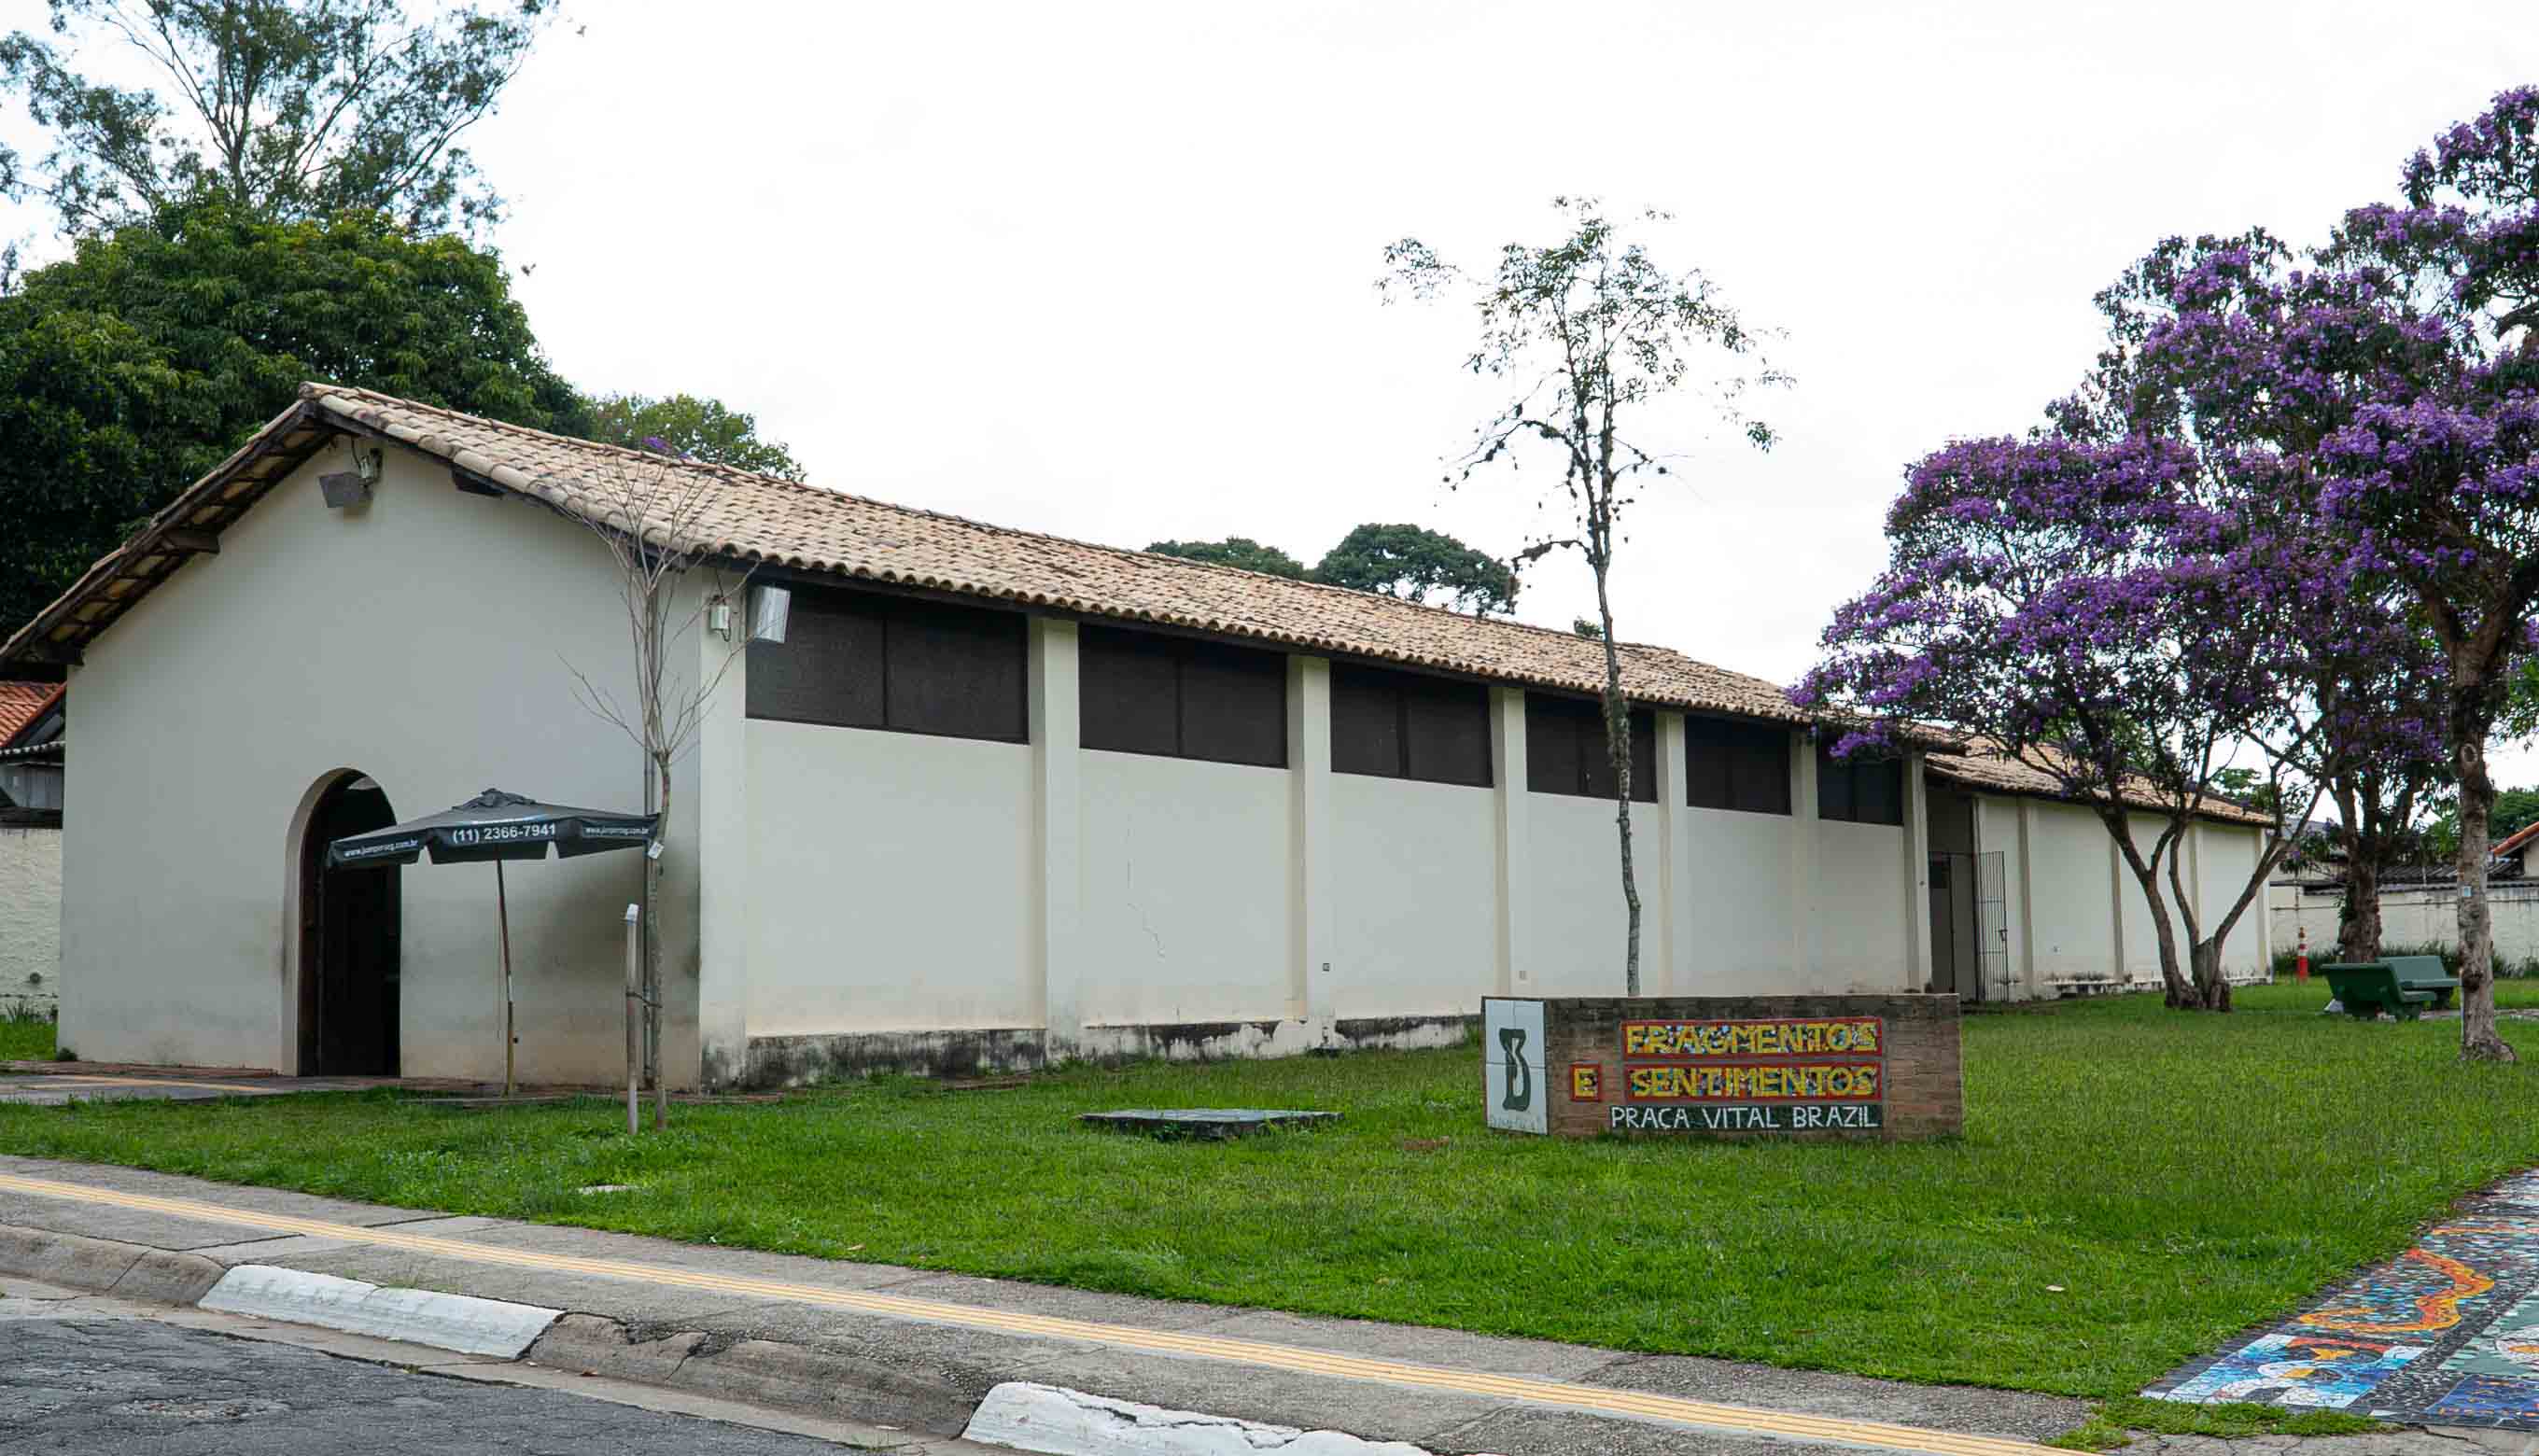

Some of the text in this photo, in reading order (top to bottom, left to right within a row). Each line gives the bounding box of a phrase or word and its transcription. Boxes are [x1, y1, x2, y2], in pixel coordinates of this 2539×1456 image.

[453, 822, 555, 844] (11) 2366-7941
[1627, 1023, 1877, 1054] FRAGMENTOS
[1573, 1066, 1876, 1098] E SENTIMENTOS
[1702, 1107, 1781, 1128] VITAL
[1792, 1105, 1879, 1128] BRAZIL
